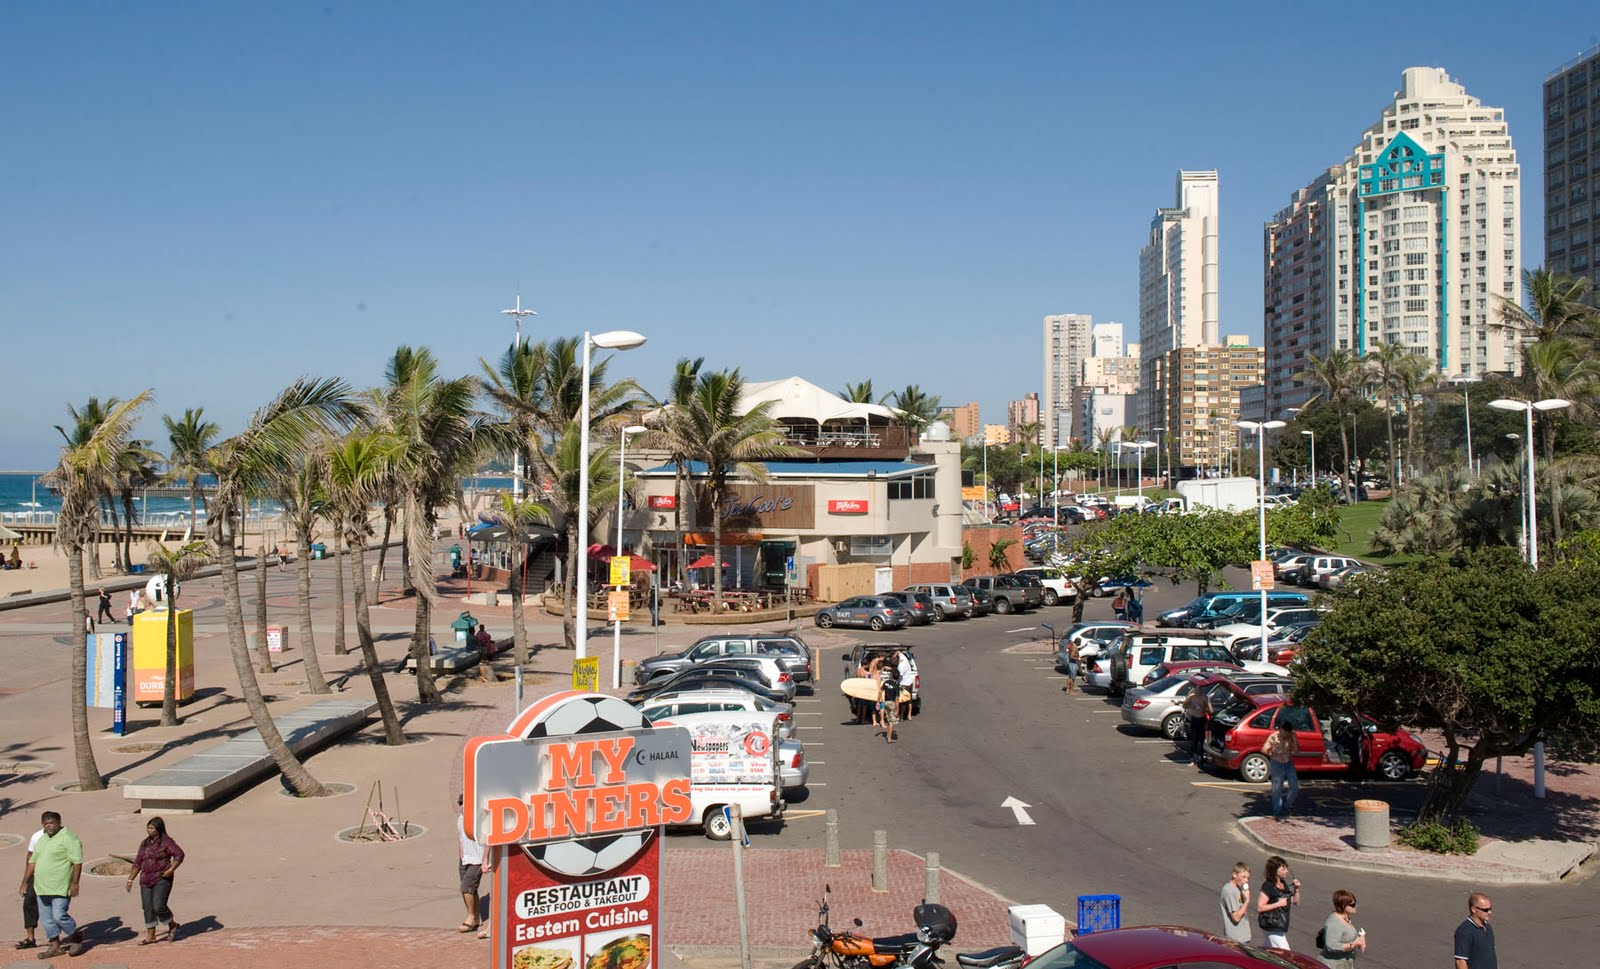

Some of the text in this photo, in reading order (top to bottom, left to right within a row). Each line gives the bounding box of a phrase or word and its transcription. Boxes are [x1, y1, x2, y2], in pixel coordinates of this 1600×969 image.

[140, 681, 165, 690] DURB
[650, 750, 679, 761] HALAAL
[690, 739, 729, 754] Newspapers
[548, 736, 635, 790] MY
[487, 778, 693, 846] DINERS
[523, 877, 642, 908] RESTAURANT
[527, 892, 638, 917] FAST FOOD & TAKEOUT
[515, 906, 649, 942] Eastern Cuisine
